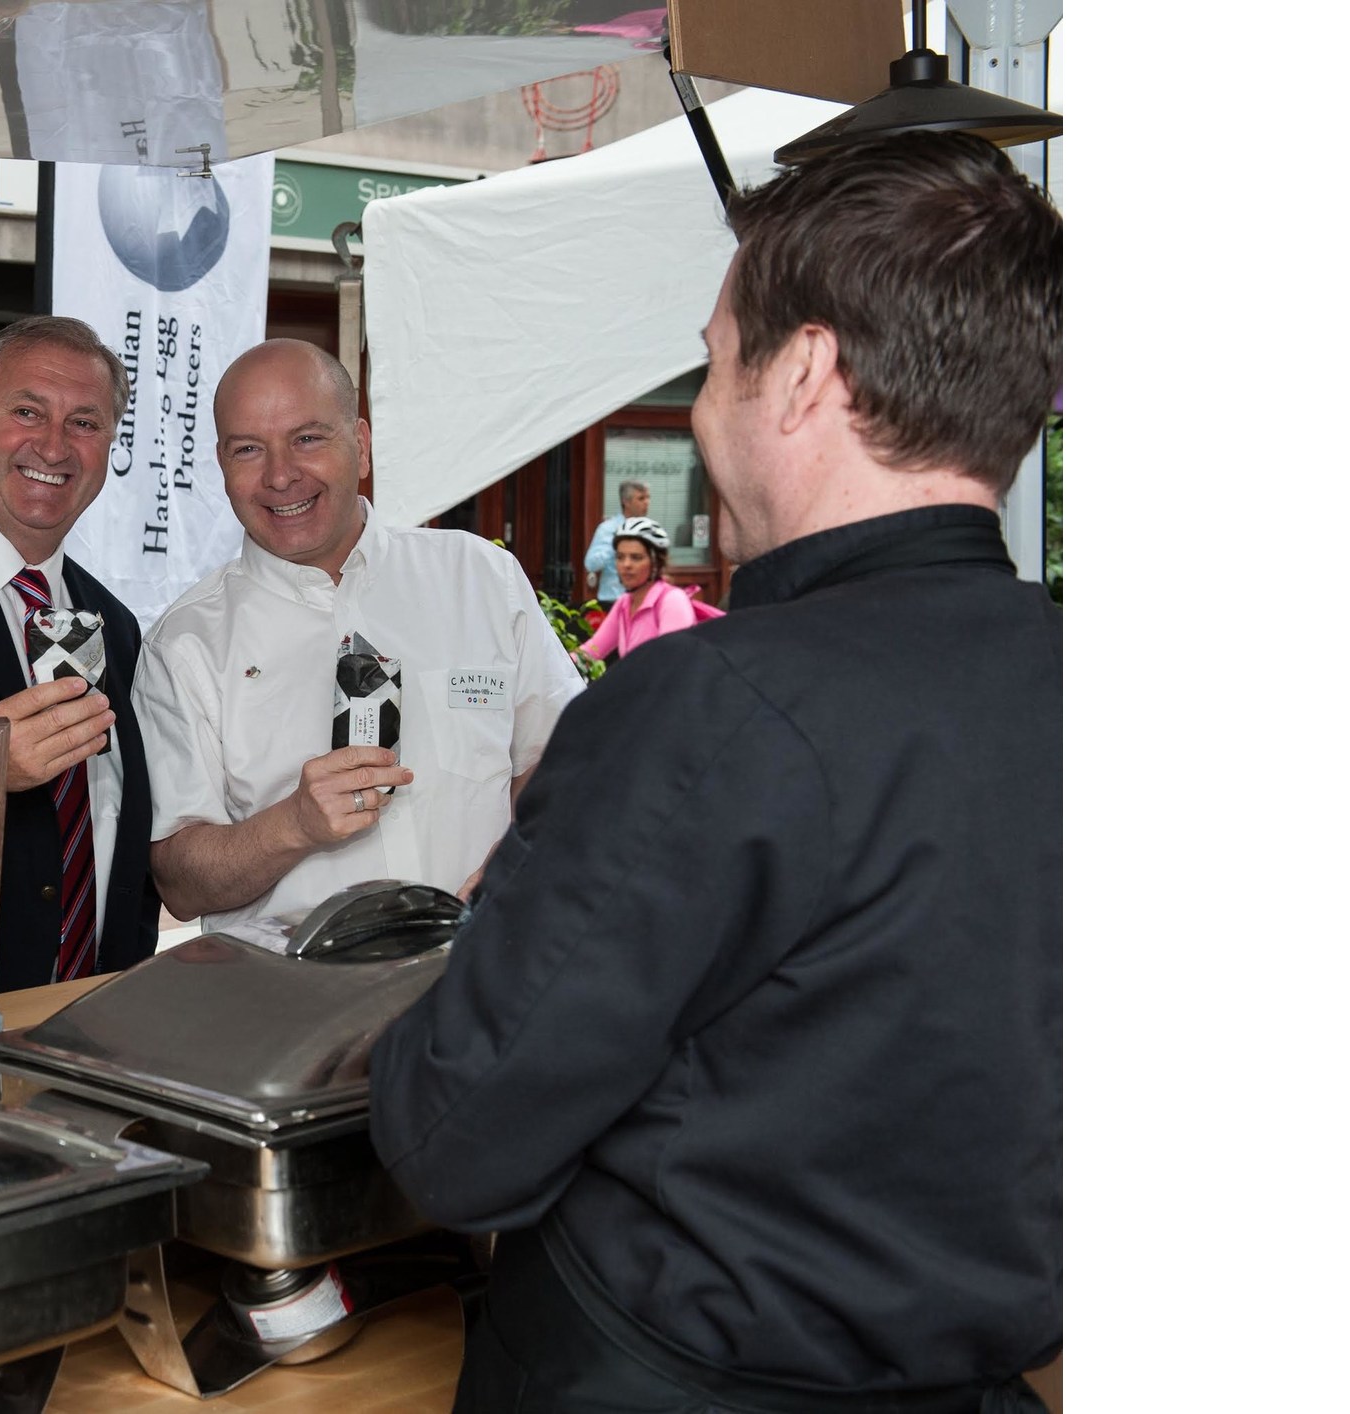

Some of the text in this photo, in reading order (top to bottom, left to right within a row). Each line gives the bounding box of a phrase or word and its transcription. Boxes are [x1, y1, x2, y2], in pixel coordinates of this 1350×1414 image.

[357, 178, 419, 202] SPA
[111, 309, 142, 477] Canian
[173, 322, 202, 492] Producers
[142, 394, 172, 556] Hatchg
[367, 707, 375, 745] CANTINE
[451, 675, 505, 689] CANTINE
